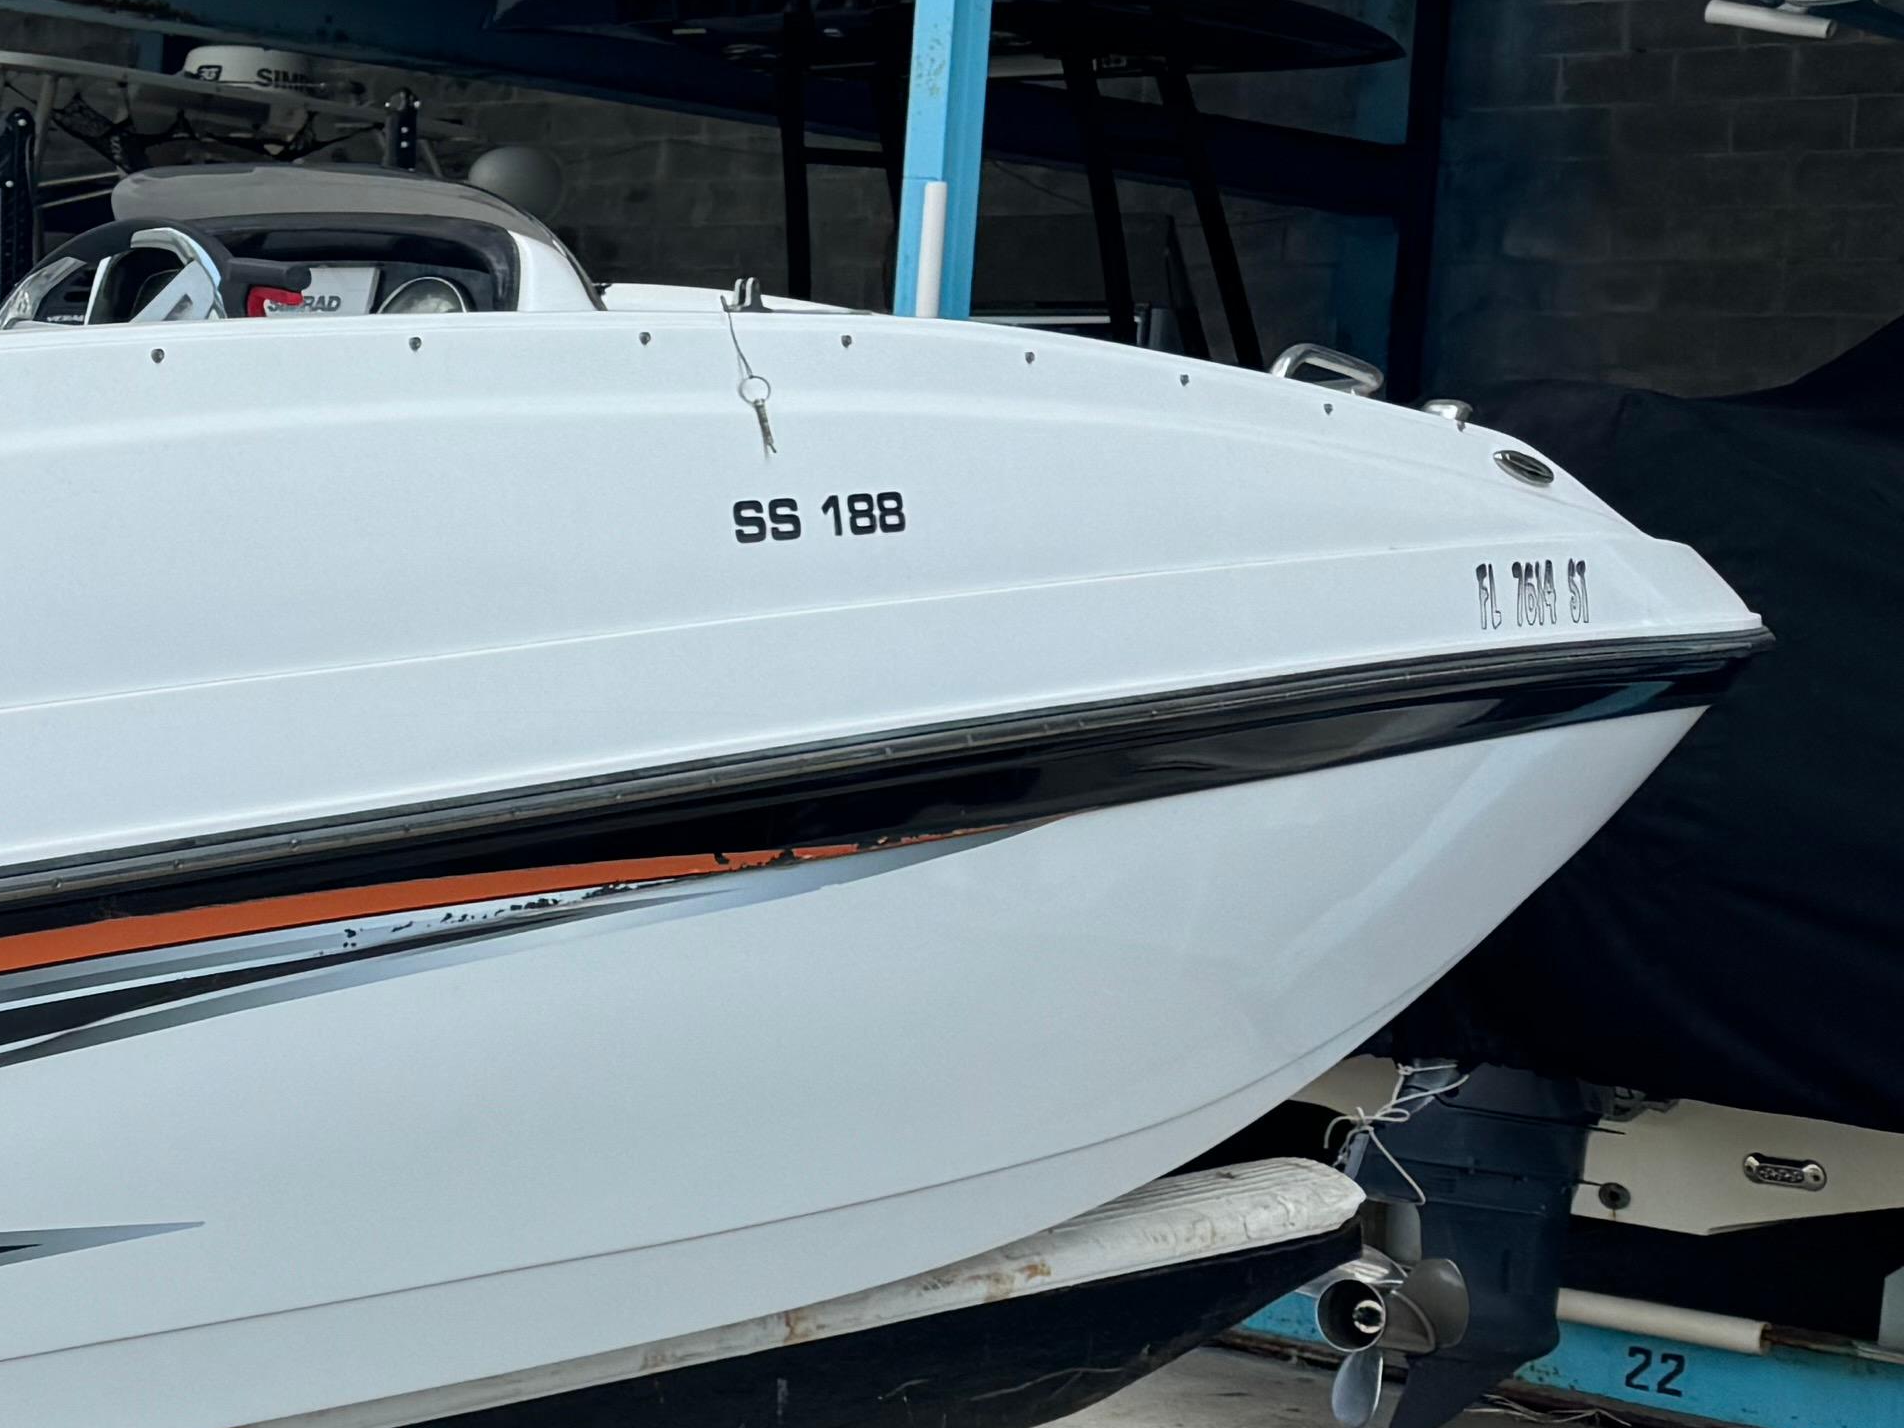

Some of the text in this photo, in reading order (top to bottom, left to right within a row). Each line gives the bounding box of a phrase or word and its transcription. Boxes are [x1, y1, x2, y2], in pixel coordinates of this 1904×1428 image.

[733, 491, 906, 543] SS 188
[1625, 1346, 1685, 1398] 22
